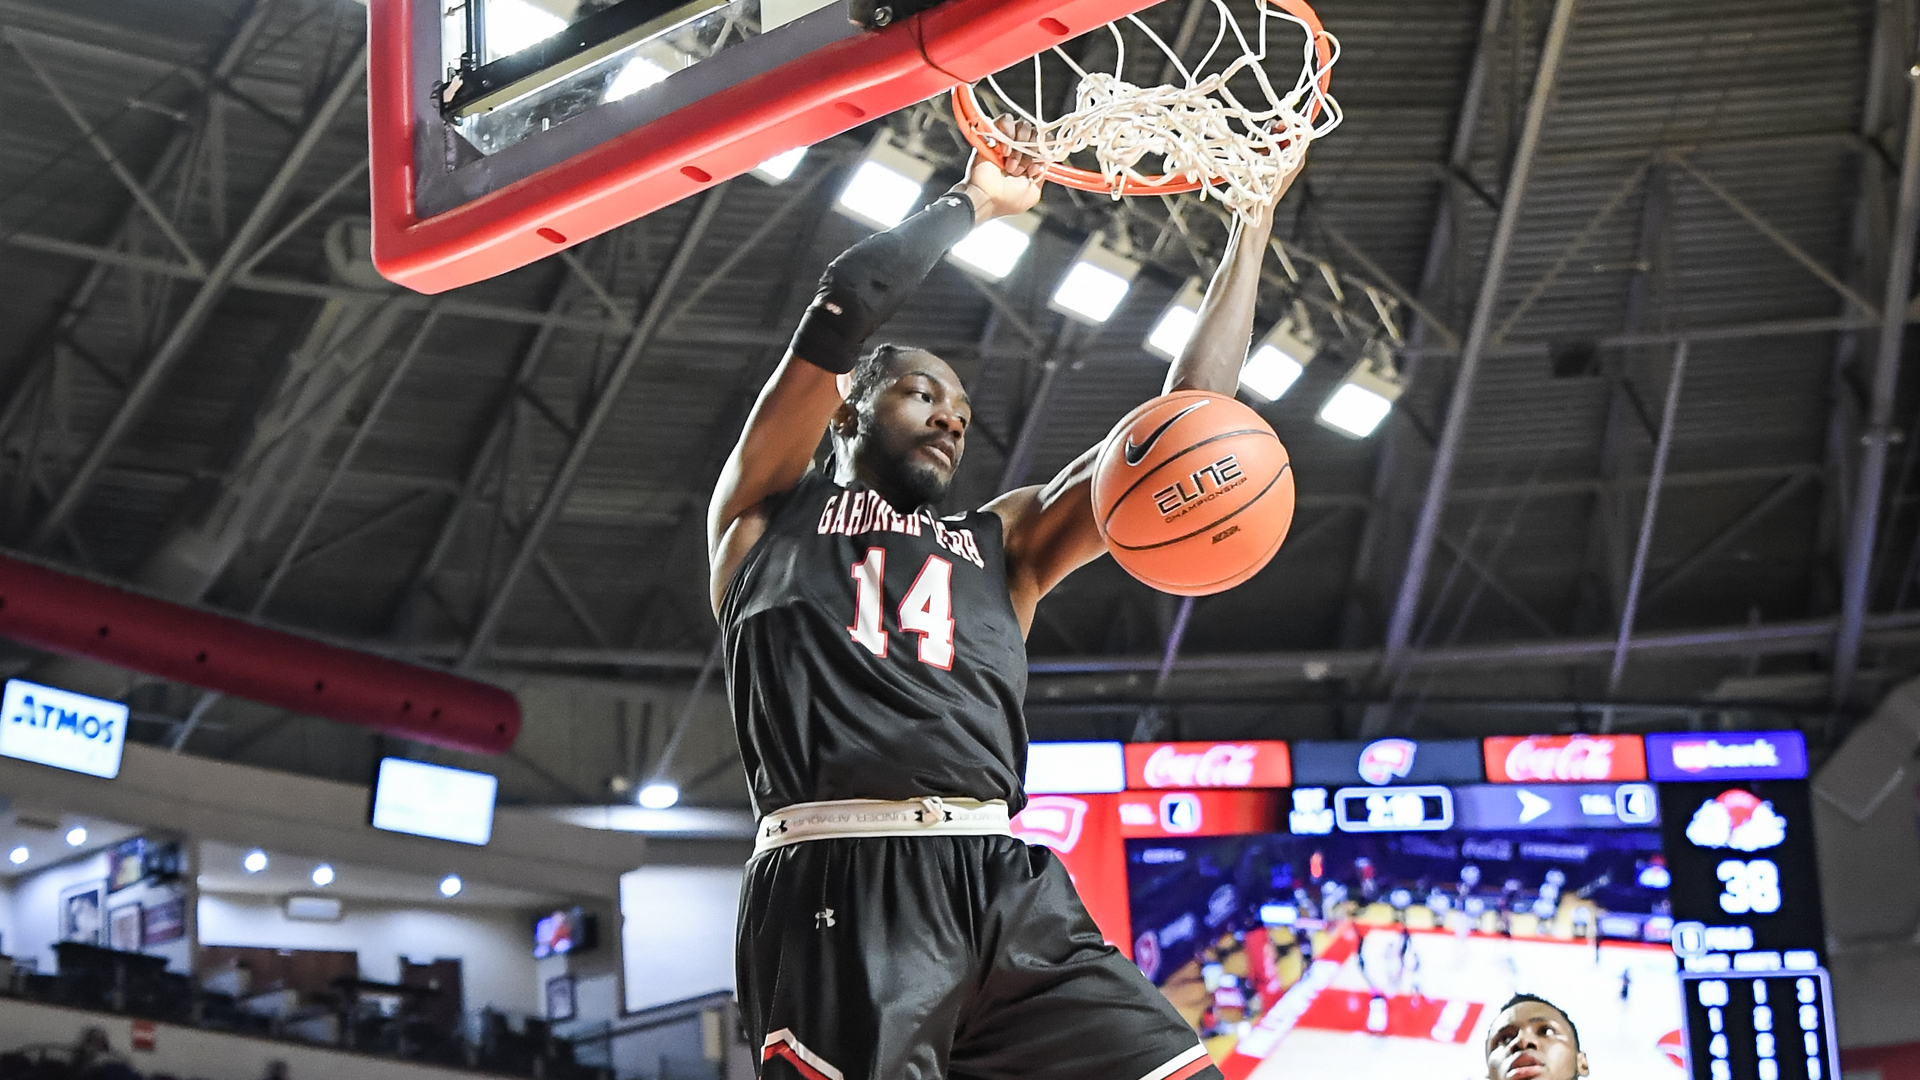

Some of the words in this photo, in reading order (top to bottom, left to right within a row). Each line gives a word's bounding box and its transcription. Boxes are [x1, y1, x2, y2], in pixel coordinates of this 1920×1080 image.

[1152, 453, 1245, 517] ELITE
[1165, 477, 1247, 523] CHAMPIONSHIP
[847, 547, 955, 671] 14
[12, 695, 114, 743] ATMOS
[1717, 859, 1781, 913] 38
